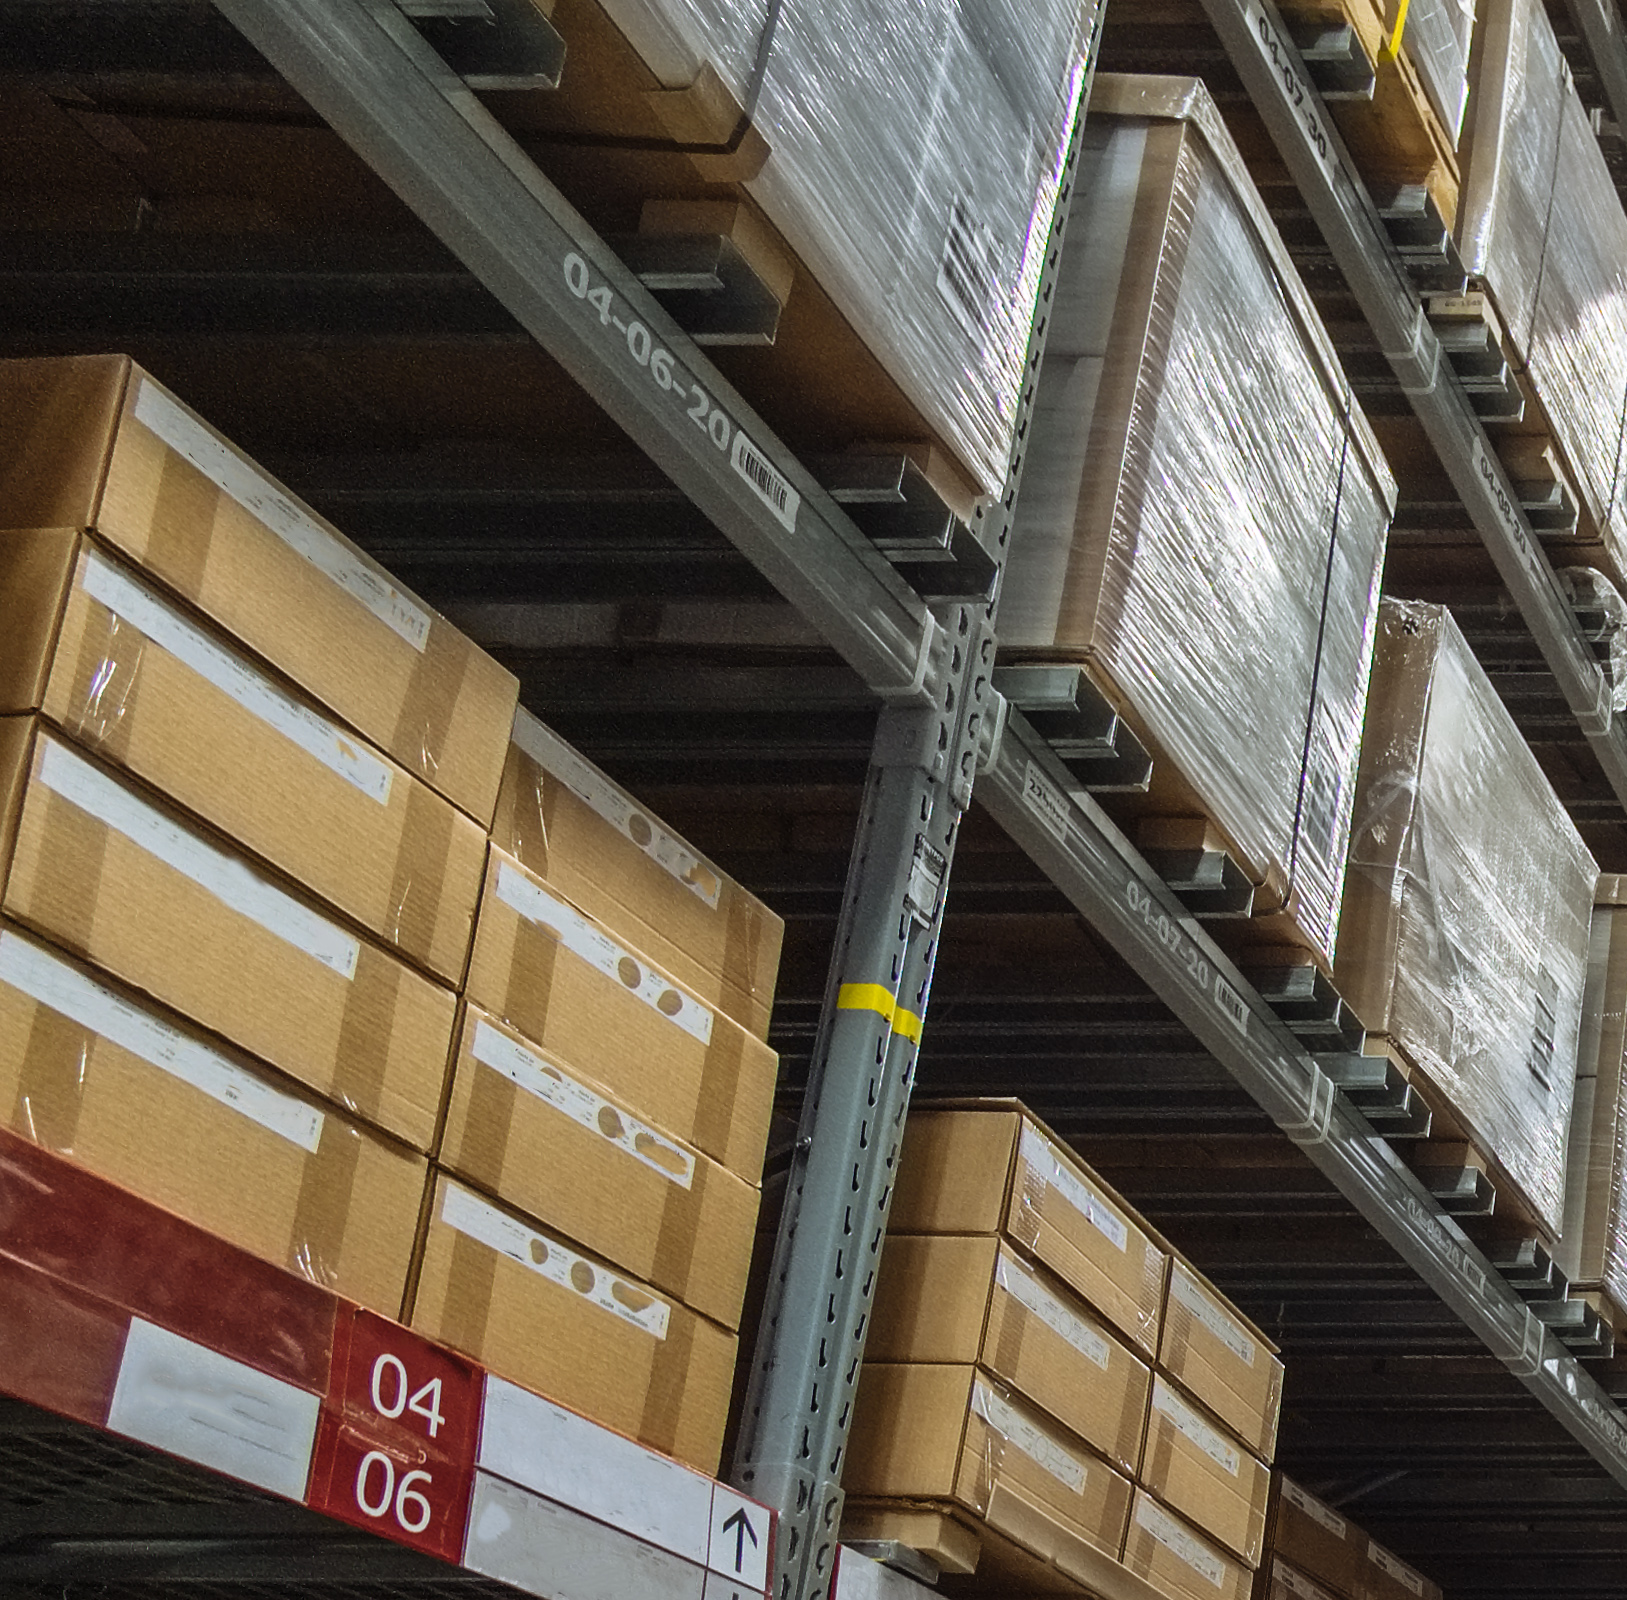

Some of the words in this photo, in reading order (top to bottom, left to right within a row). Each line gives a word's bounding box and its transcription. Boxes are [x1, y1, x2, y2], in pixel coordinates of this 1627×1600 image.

[1258, 15, 1327, 160] 04-07-30
[563, 251, 732, 452] 04-06-20
[1126, 879, 1209, 990] 04-07-20
[371, 1353, 446, 1438] 04
[356, 1450, 433, 1533] 06
